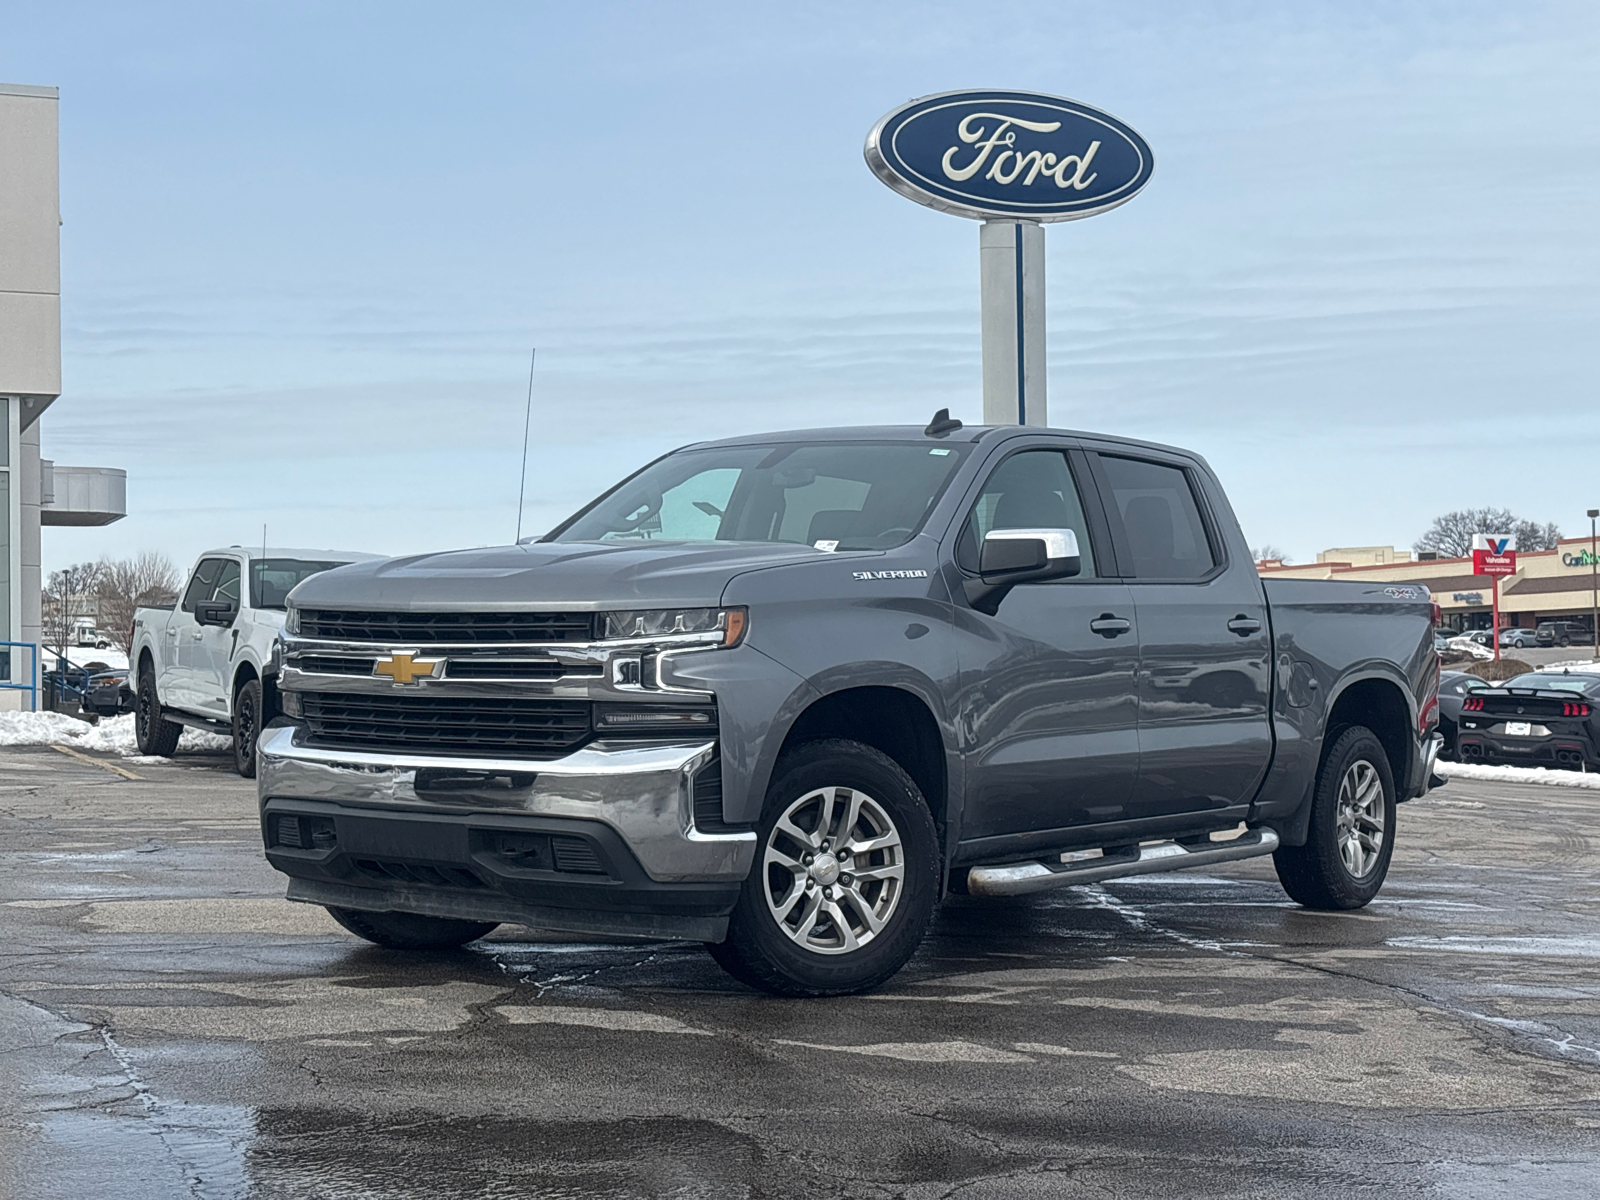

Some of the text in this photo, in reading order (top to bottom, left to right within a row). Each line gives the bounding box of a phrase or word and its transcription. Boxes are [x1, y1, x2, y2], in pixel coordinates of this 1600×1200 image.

[942, 112, 1102, 190] Ford
[1485, 556, 1511, 564] Valvoline
[853, 570, 927, 580] SILVERADO
